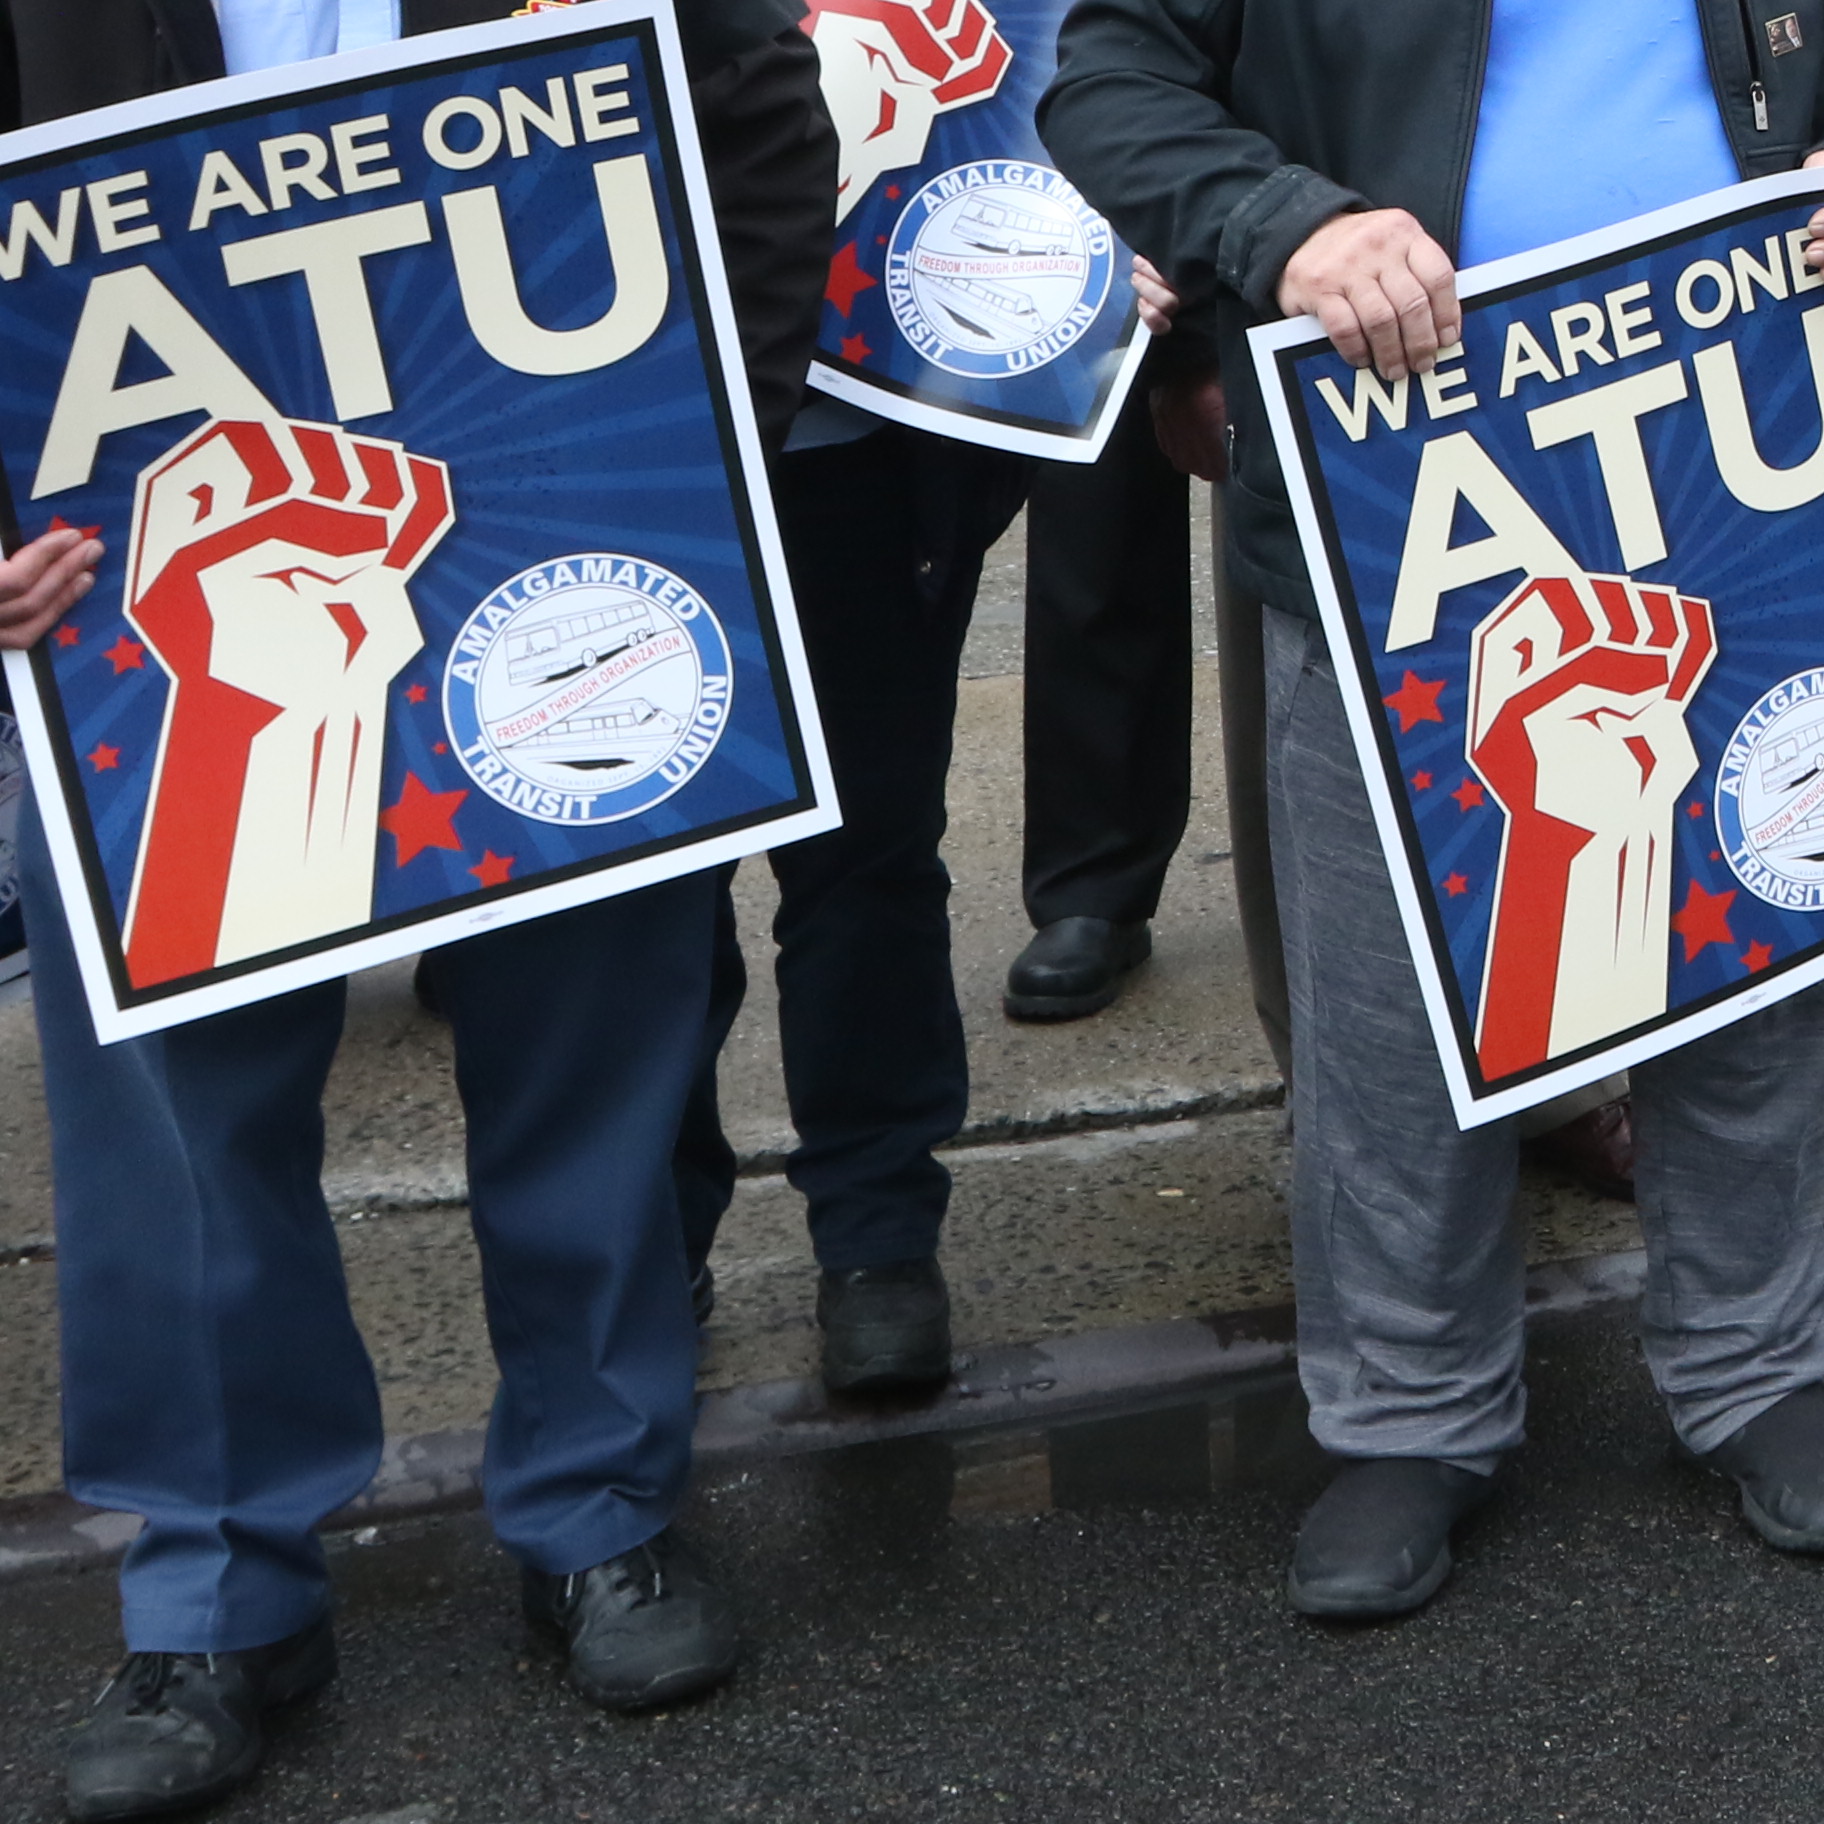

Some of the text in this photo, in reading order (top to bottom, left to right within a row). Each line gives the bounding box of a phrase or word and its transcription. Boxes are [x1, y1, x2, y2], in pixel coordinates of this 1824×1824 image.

[0, 63, 640, 281] WE ARE ONE
[921, 164, 1109, 257] AMALGAMATED
[890, 250, 954, 360] TRANSIT
[918, 255, 1081, 275] FREEDOM THROUGH ORGANIZATION
[30, 153, 670, 501] ATU
[1005, 303, 1094, 370] UNION
[1314, 341, 1477, 443] WE
[1500, 281, 1662, 399] ARE
[452, 558, 700, 685] AMALGAMATED
[496, 635, 681, 740] FREEDOM THROUGH ORGANIZATION
[658, 675, 727, 784] UNION
[462, 735, 597, 819] TRANSIT
[1755, 813, 1793, 844] FREEDOM
